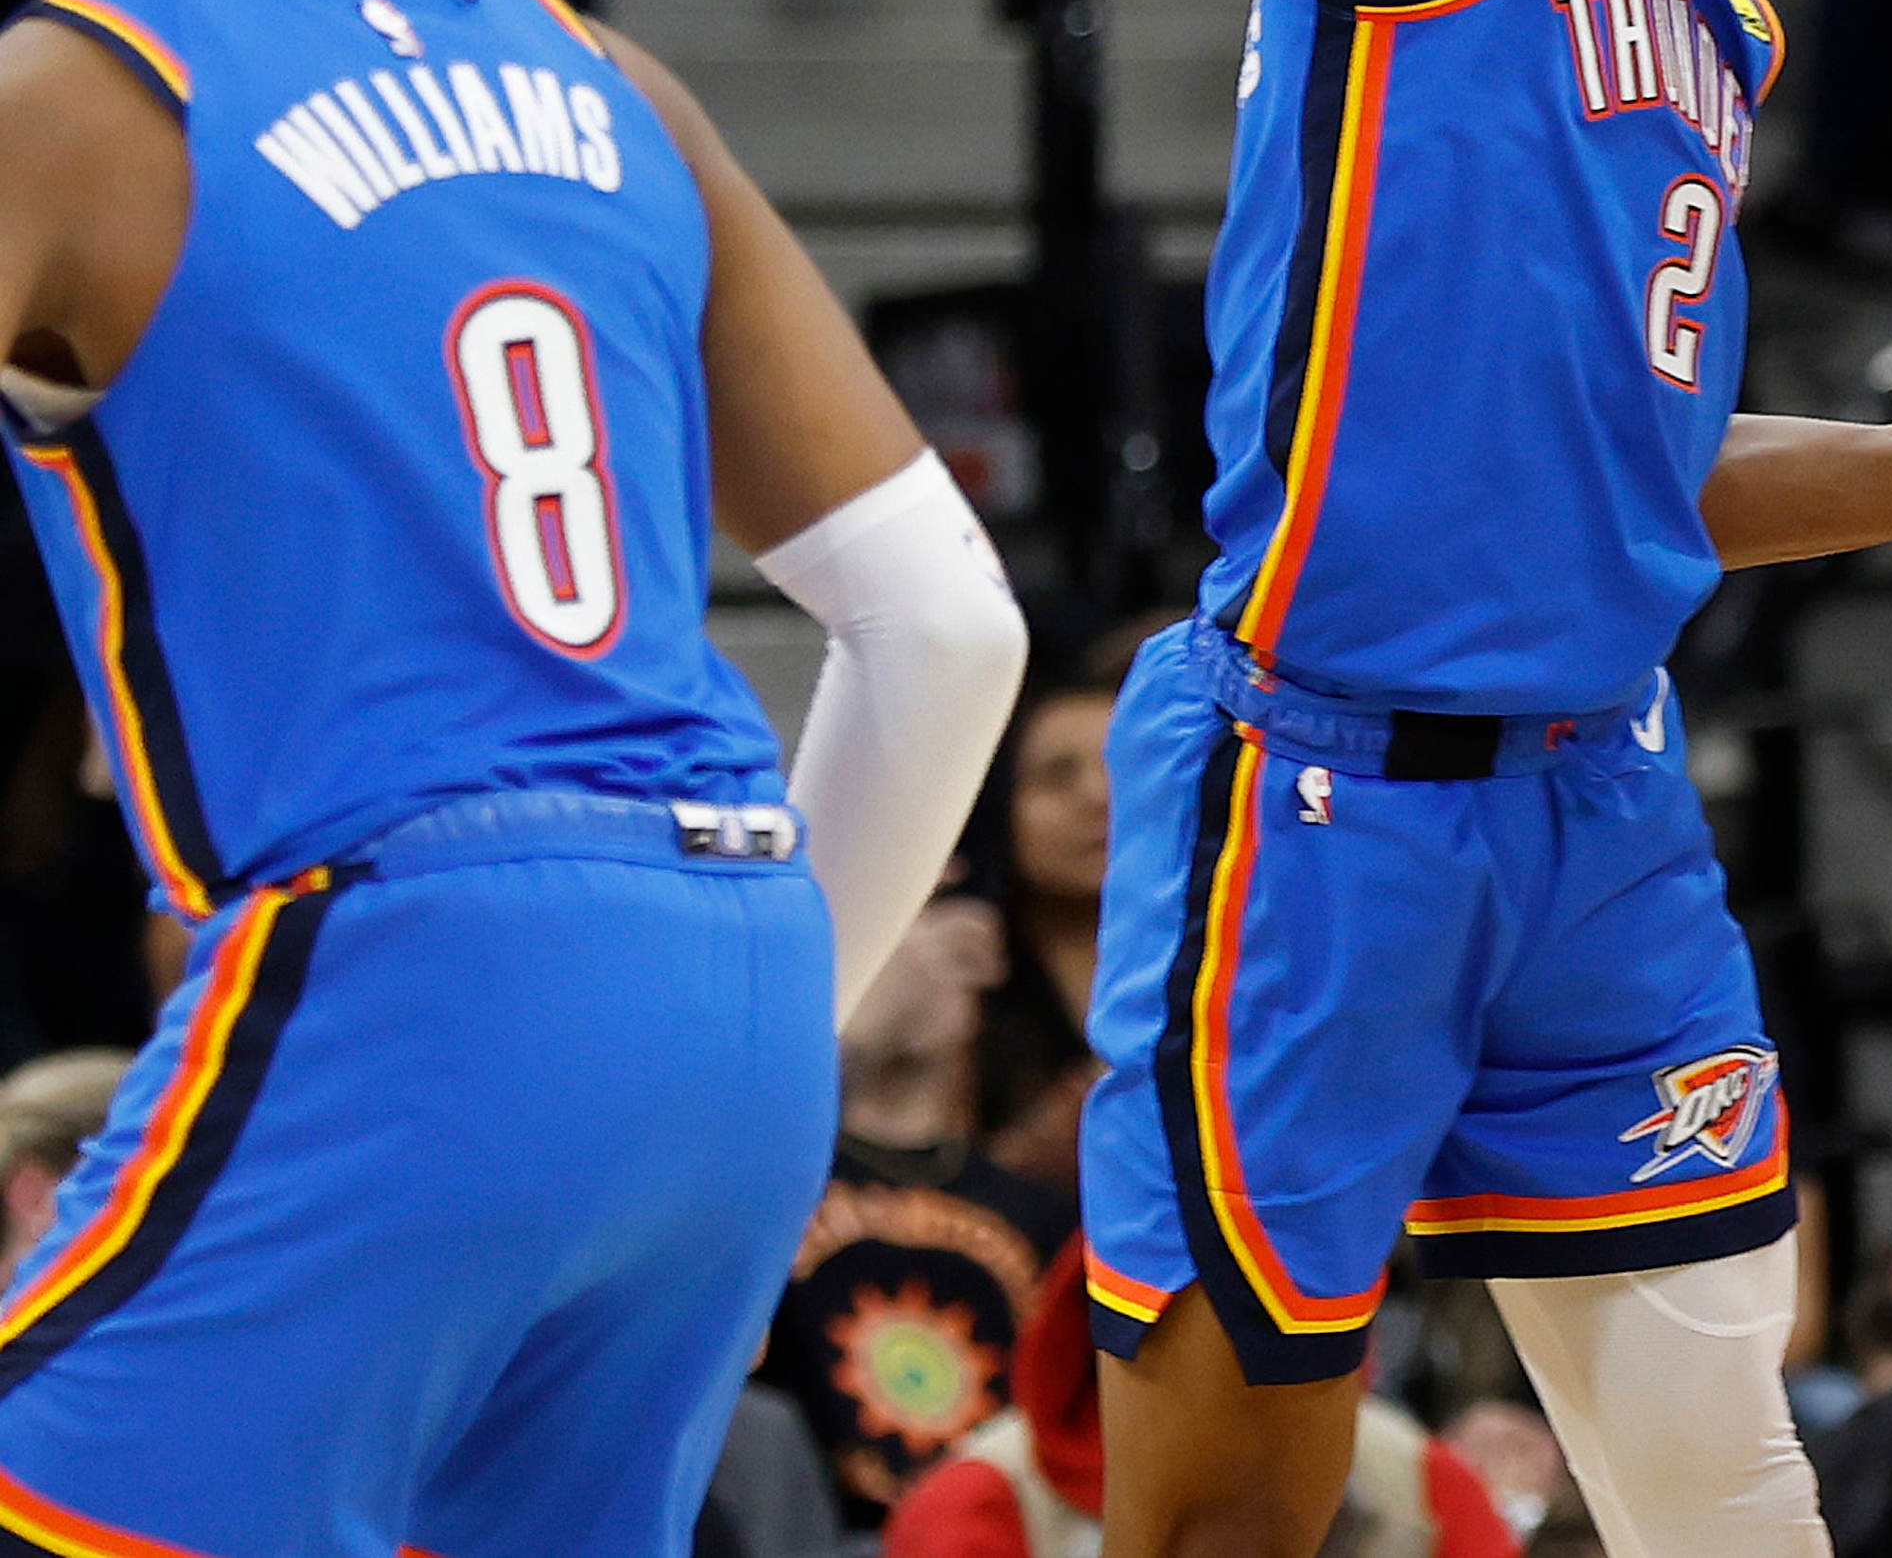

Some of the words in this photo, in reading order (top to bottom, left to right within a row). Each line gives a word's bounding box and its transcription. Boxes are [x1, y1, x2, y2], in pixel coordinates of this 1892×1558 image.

[255, 61, 622, 230] WILLIAMS
[1644, 172, 1726, 394] 2
[442, 276, 630, 662] 8
